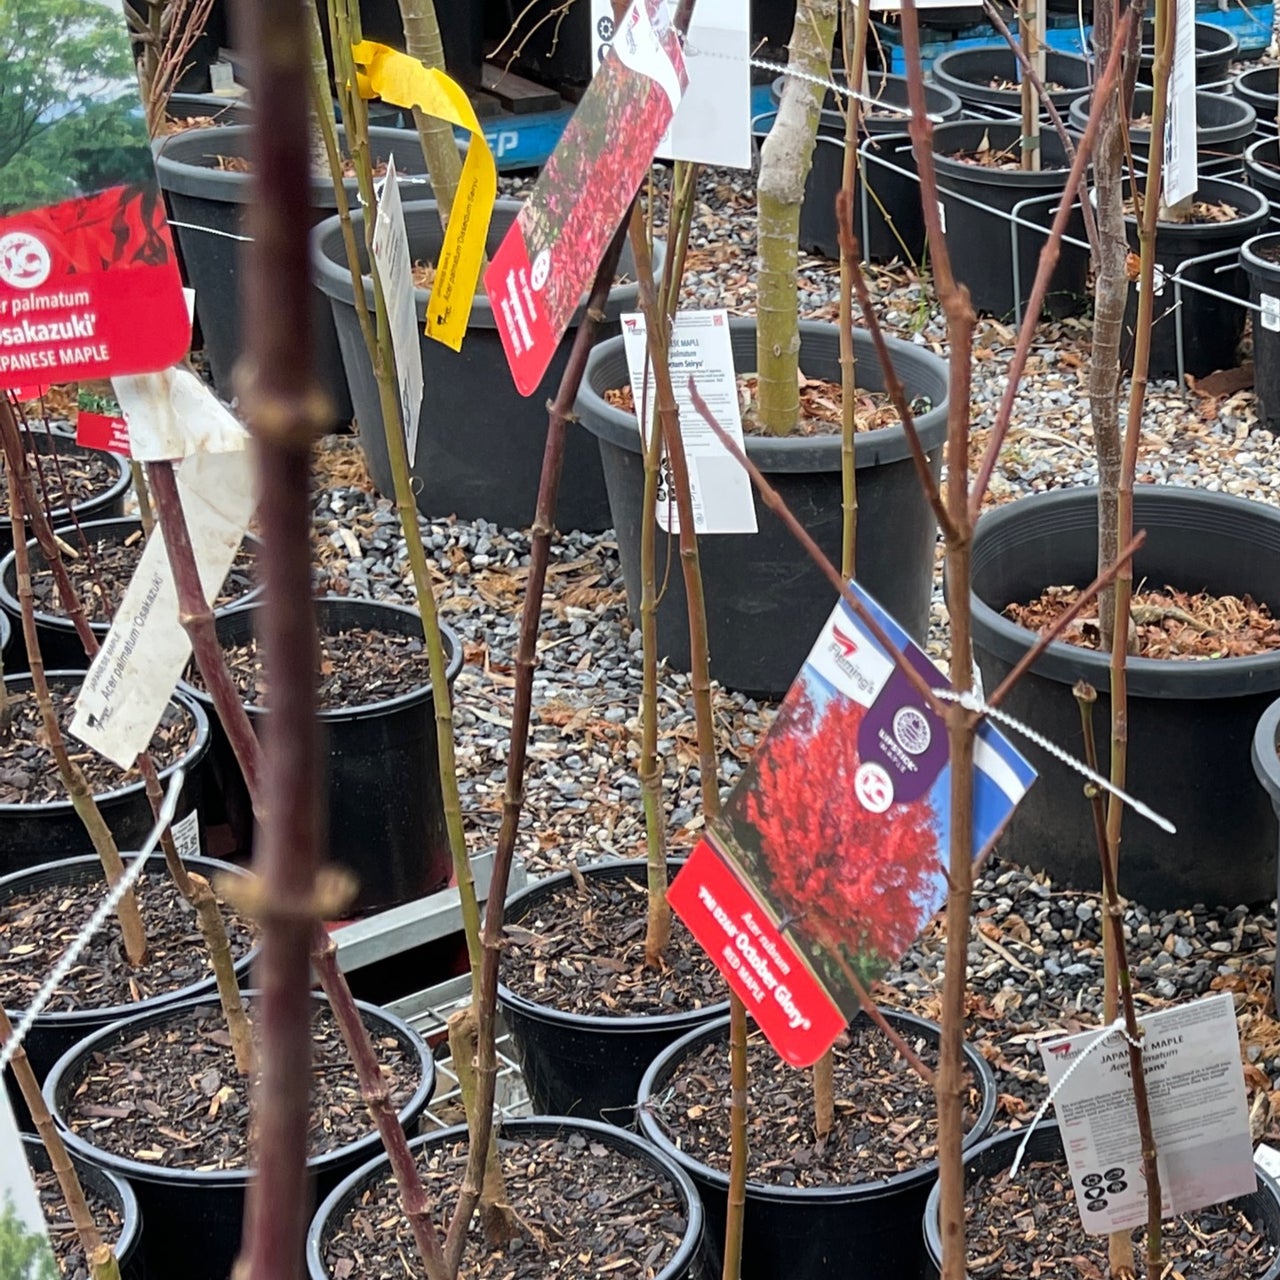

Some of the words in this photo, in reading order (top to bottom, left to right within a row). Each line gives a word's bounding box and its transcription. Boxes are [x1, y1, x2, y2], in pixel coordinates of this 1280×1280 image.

[11, 291, 91, 317] palmatum
[60, 344, 110, 365] MAPLE
[101, 673, 117, 702] Acer
[735, 932, 779, 991] October
[1151, 1035, 1185, 1051] MAPLE
[1142, 1049, 1179, 1064] lmatum
